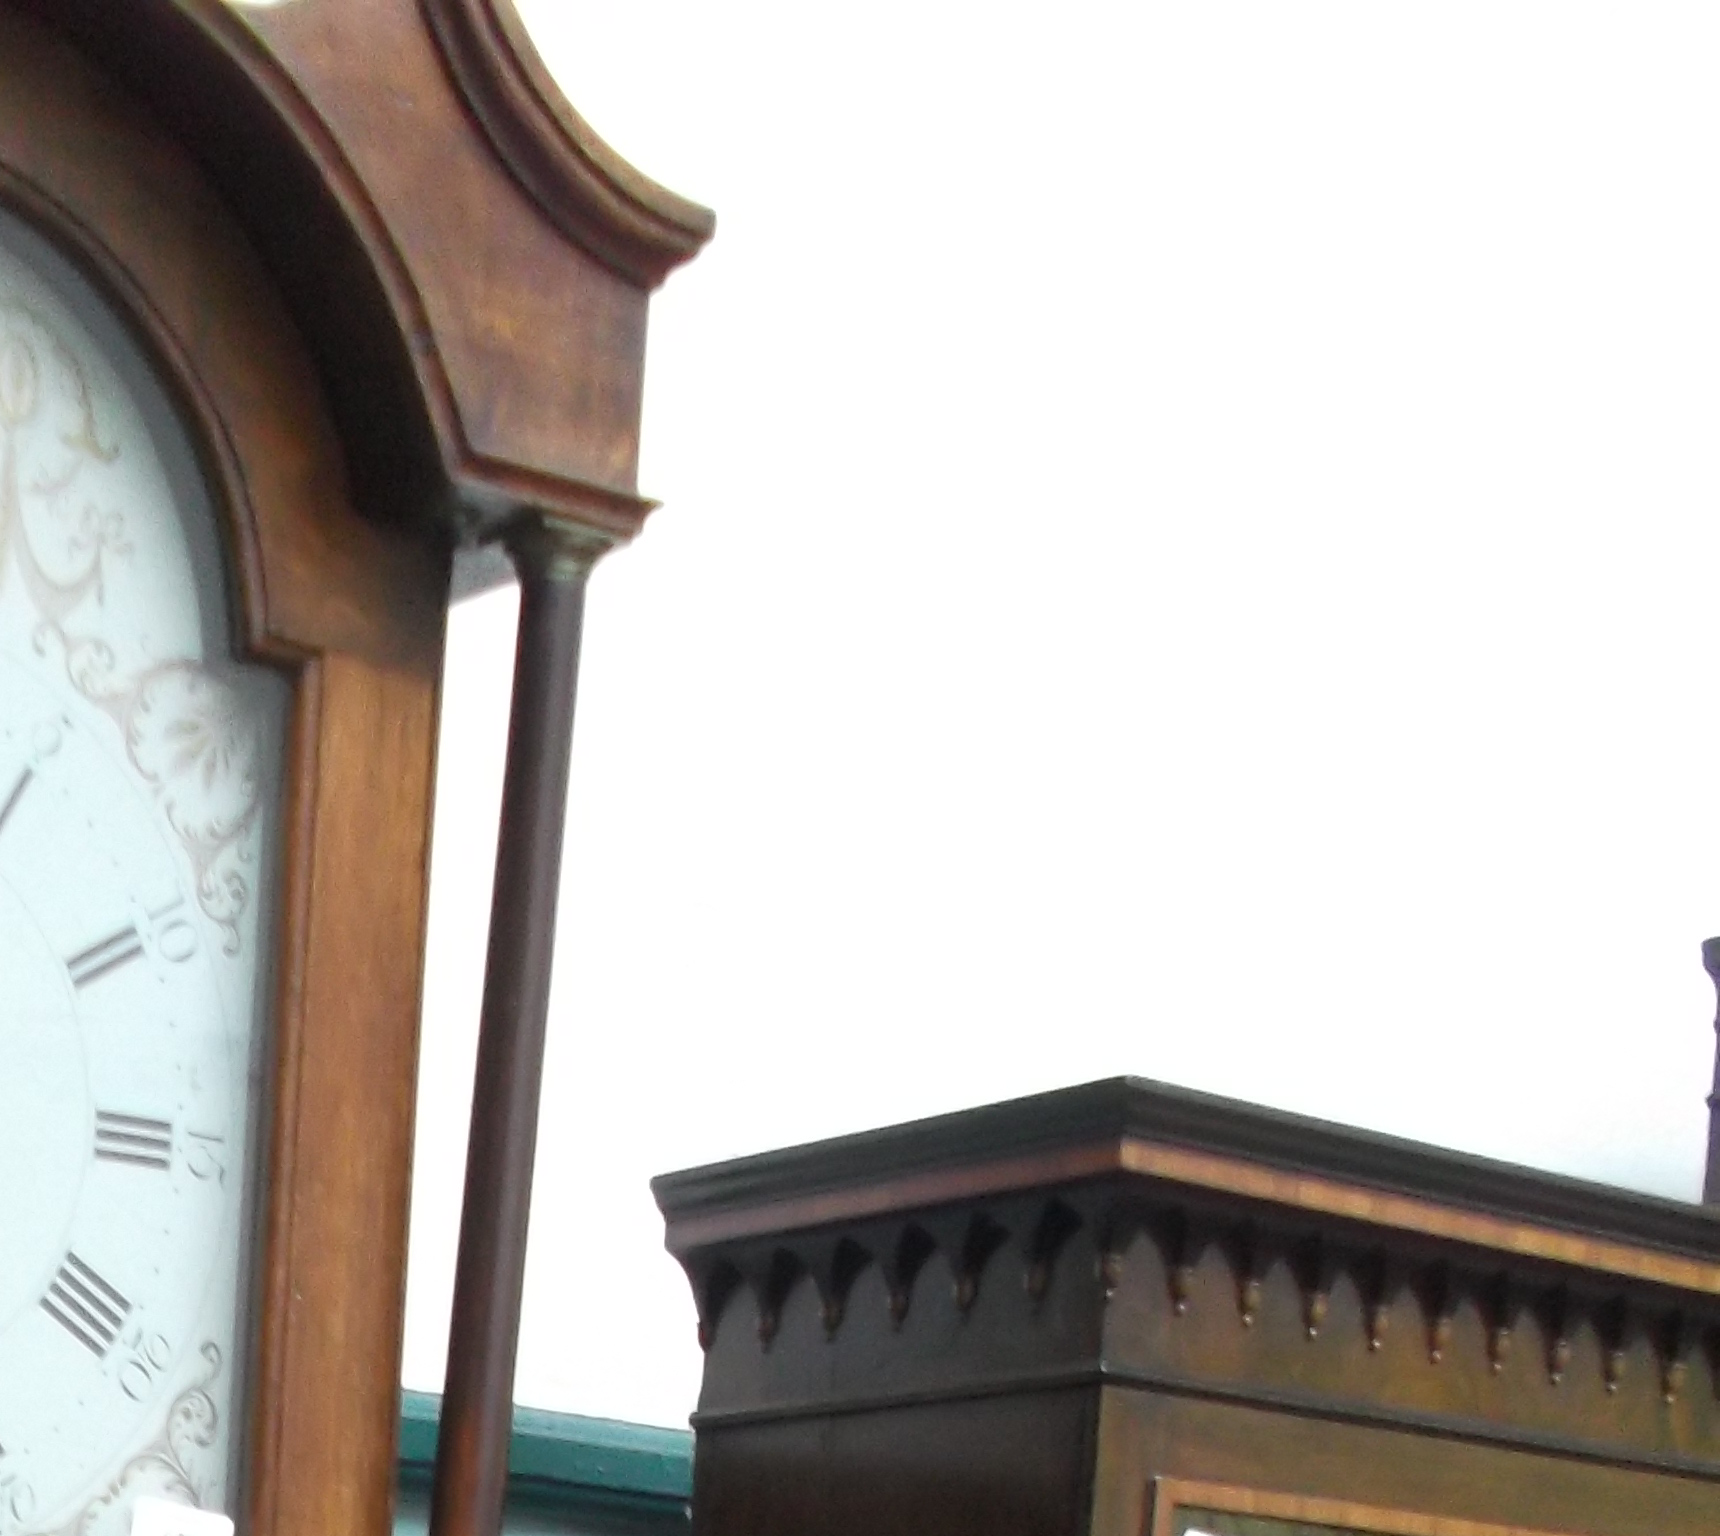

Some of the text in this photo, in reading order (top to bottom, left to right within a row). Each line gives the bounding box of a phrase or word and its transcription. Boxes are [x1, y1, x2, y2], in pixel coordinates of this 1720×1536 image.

[32, 713, 75, 758] 5
[65, 923, 146, 992] II
[147, 895, 199, 965] 10
[93, 1106, 173, 1172] III
[186, 1127, 226, 1189] 15
[38, 1250, 133, 1359] IIII
[117, 1328, 172, 1404] 20
